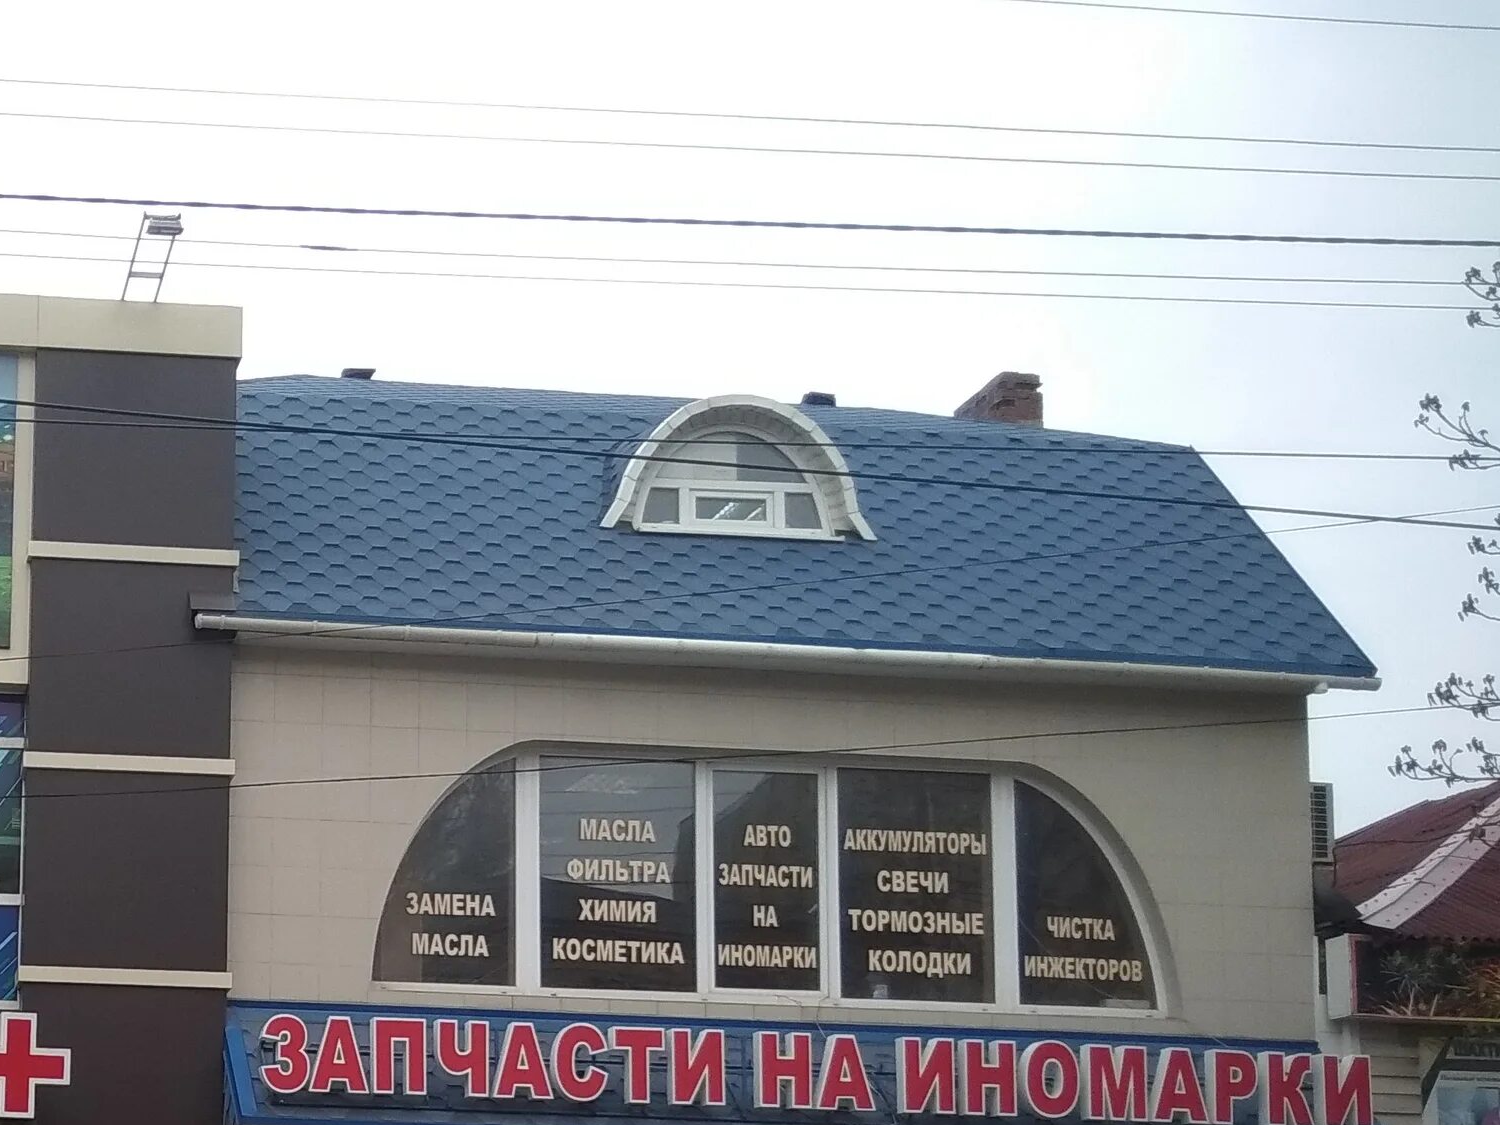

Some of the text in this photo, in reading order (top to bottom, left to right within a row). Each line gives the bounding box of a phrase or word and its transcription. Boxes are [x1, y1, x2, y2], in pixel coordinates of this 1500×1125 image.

[580, 818, 656, 842] МАСЛА
[743, 824, 792, 847] АВТО
[843, 828, 987, 856] АККУМУЛЯТОРЫ
[567, 857, 672, 884] ФИЛЬТРА
[718, 863, 813, 888] ЗАПЧАСТИ
[876, 869, 949, 894] СВЕЧИ
[405, 892, 497, 917] ЗАМЕНА
[578, 898, 657, 923] ХИМИЯ
[752, 904, 778, 928] НА
[847, 908, 985, 935] ТОРМОЗНЫЕ
[1046, 915, 1116, 941] ЧИСТКА
[411, 932, 490, 958] МАСЛА
[552, 937, 685, 965] КОСМЕТИКА
[717, 943, 817, 969] ИНОМАРКИ
[867, 949, 972, 979] КОЛОДКИ
[1024, 955, 1143, 982] ИНЖЕКТОРОВ
[258, 1012, 727, 1107] ЗАПЧАСТИ
[753, 1030, 877, 1112] НА
